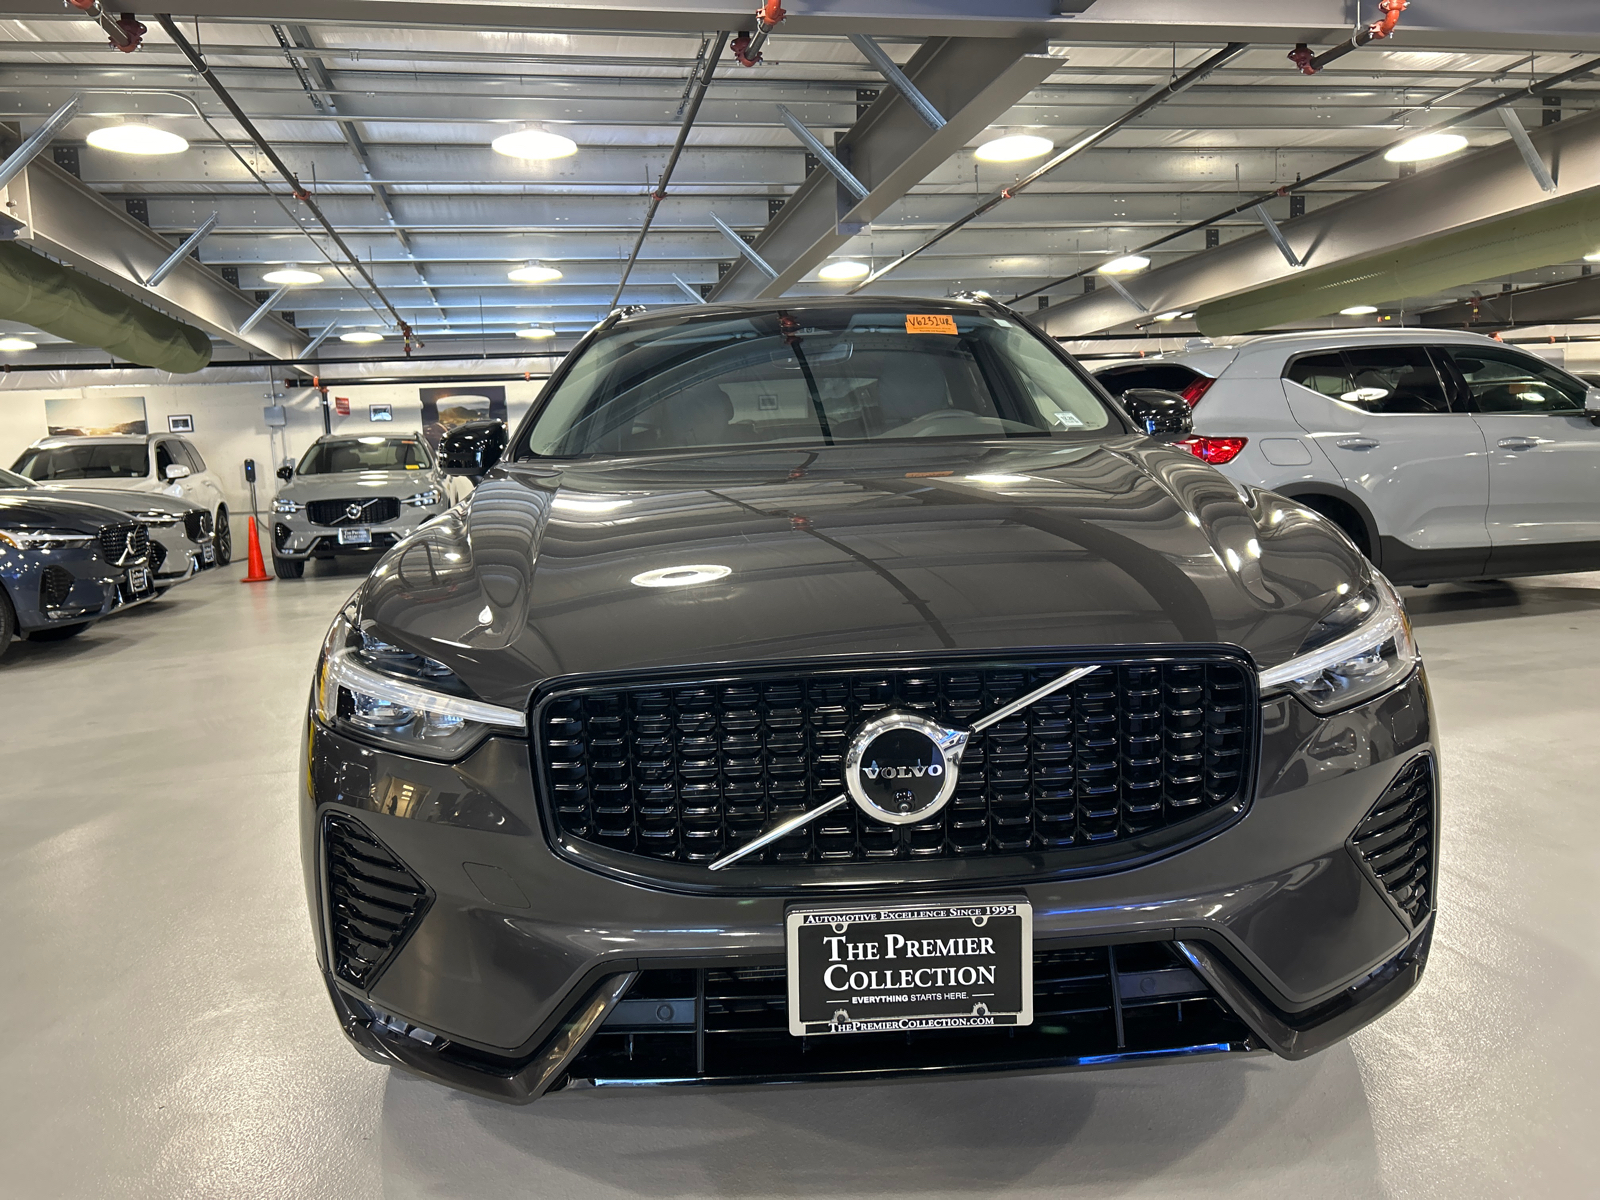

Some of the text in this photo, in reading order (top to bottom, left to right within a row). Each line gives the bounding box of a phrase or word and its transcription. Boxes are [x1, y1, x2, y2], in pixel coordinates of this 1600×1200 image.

[862, 764, 943, 779] VOLVO
[805, 905, 1015, 924] AUTOMOTIVE EXCELLENCE SINCE 1995
[823, 933, 996, 962] THE PREMIER
[823, 963, 996, 992] COLLECTION
[852, 991, 969, 1004] EVERYTHING STARTS HERE.
[828, 1017, 994, 1033] THEPREMIERCOLLECTION.COM
